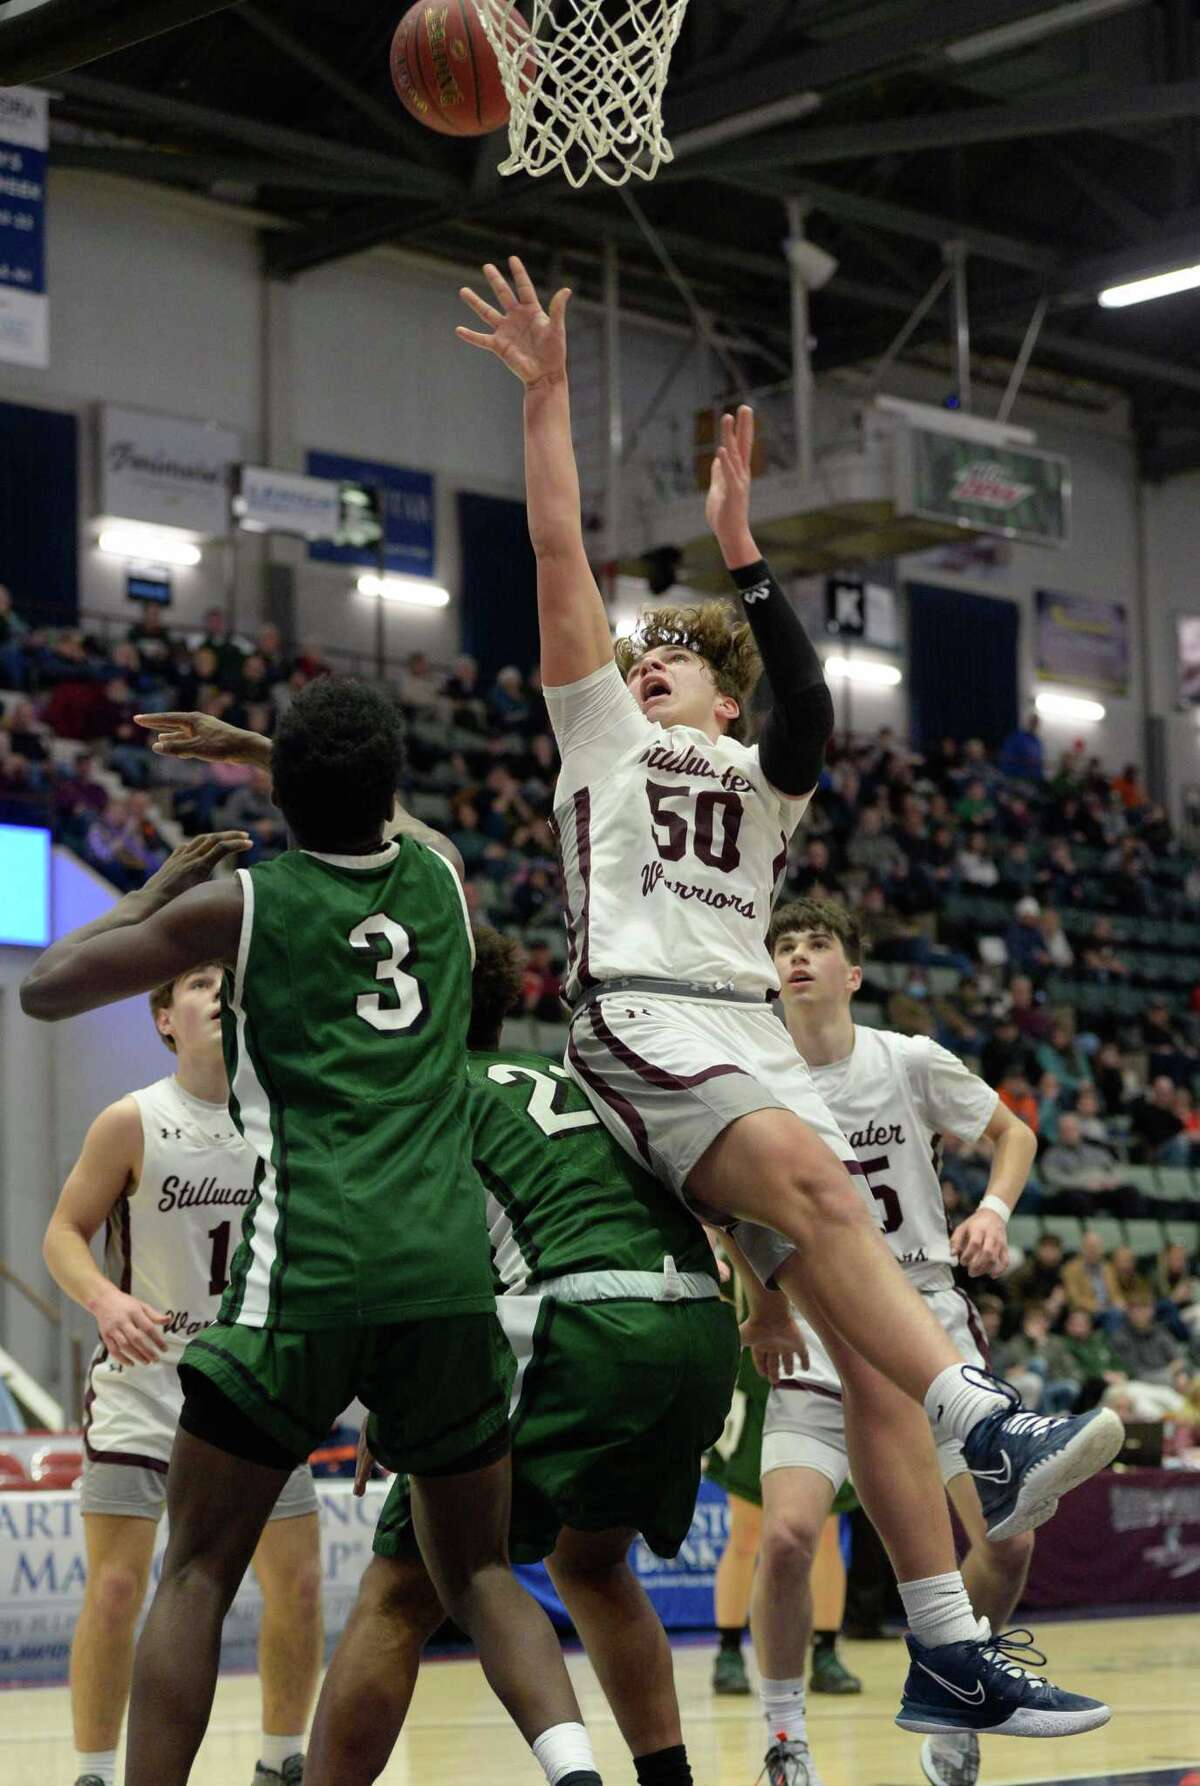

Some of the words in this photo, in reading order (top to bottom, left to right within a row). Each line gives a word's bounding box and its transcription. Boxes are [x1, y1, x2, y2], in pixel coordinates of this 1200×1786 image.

[645, 778, 744, 873] 50
[348, 912, 424, 1035] 3
[487, 1063, 600, 1137] 2
[845, 1119, 906, 1149] ater
